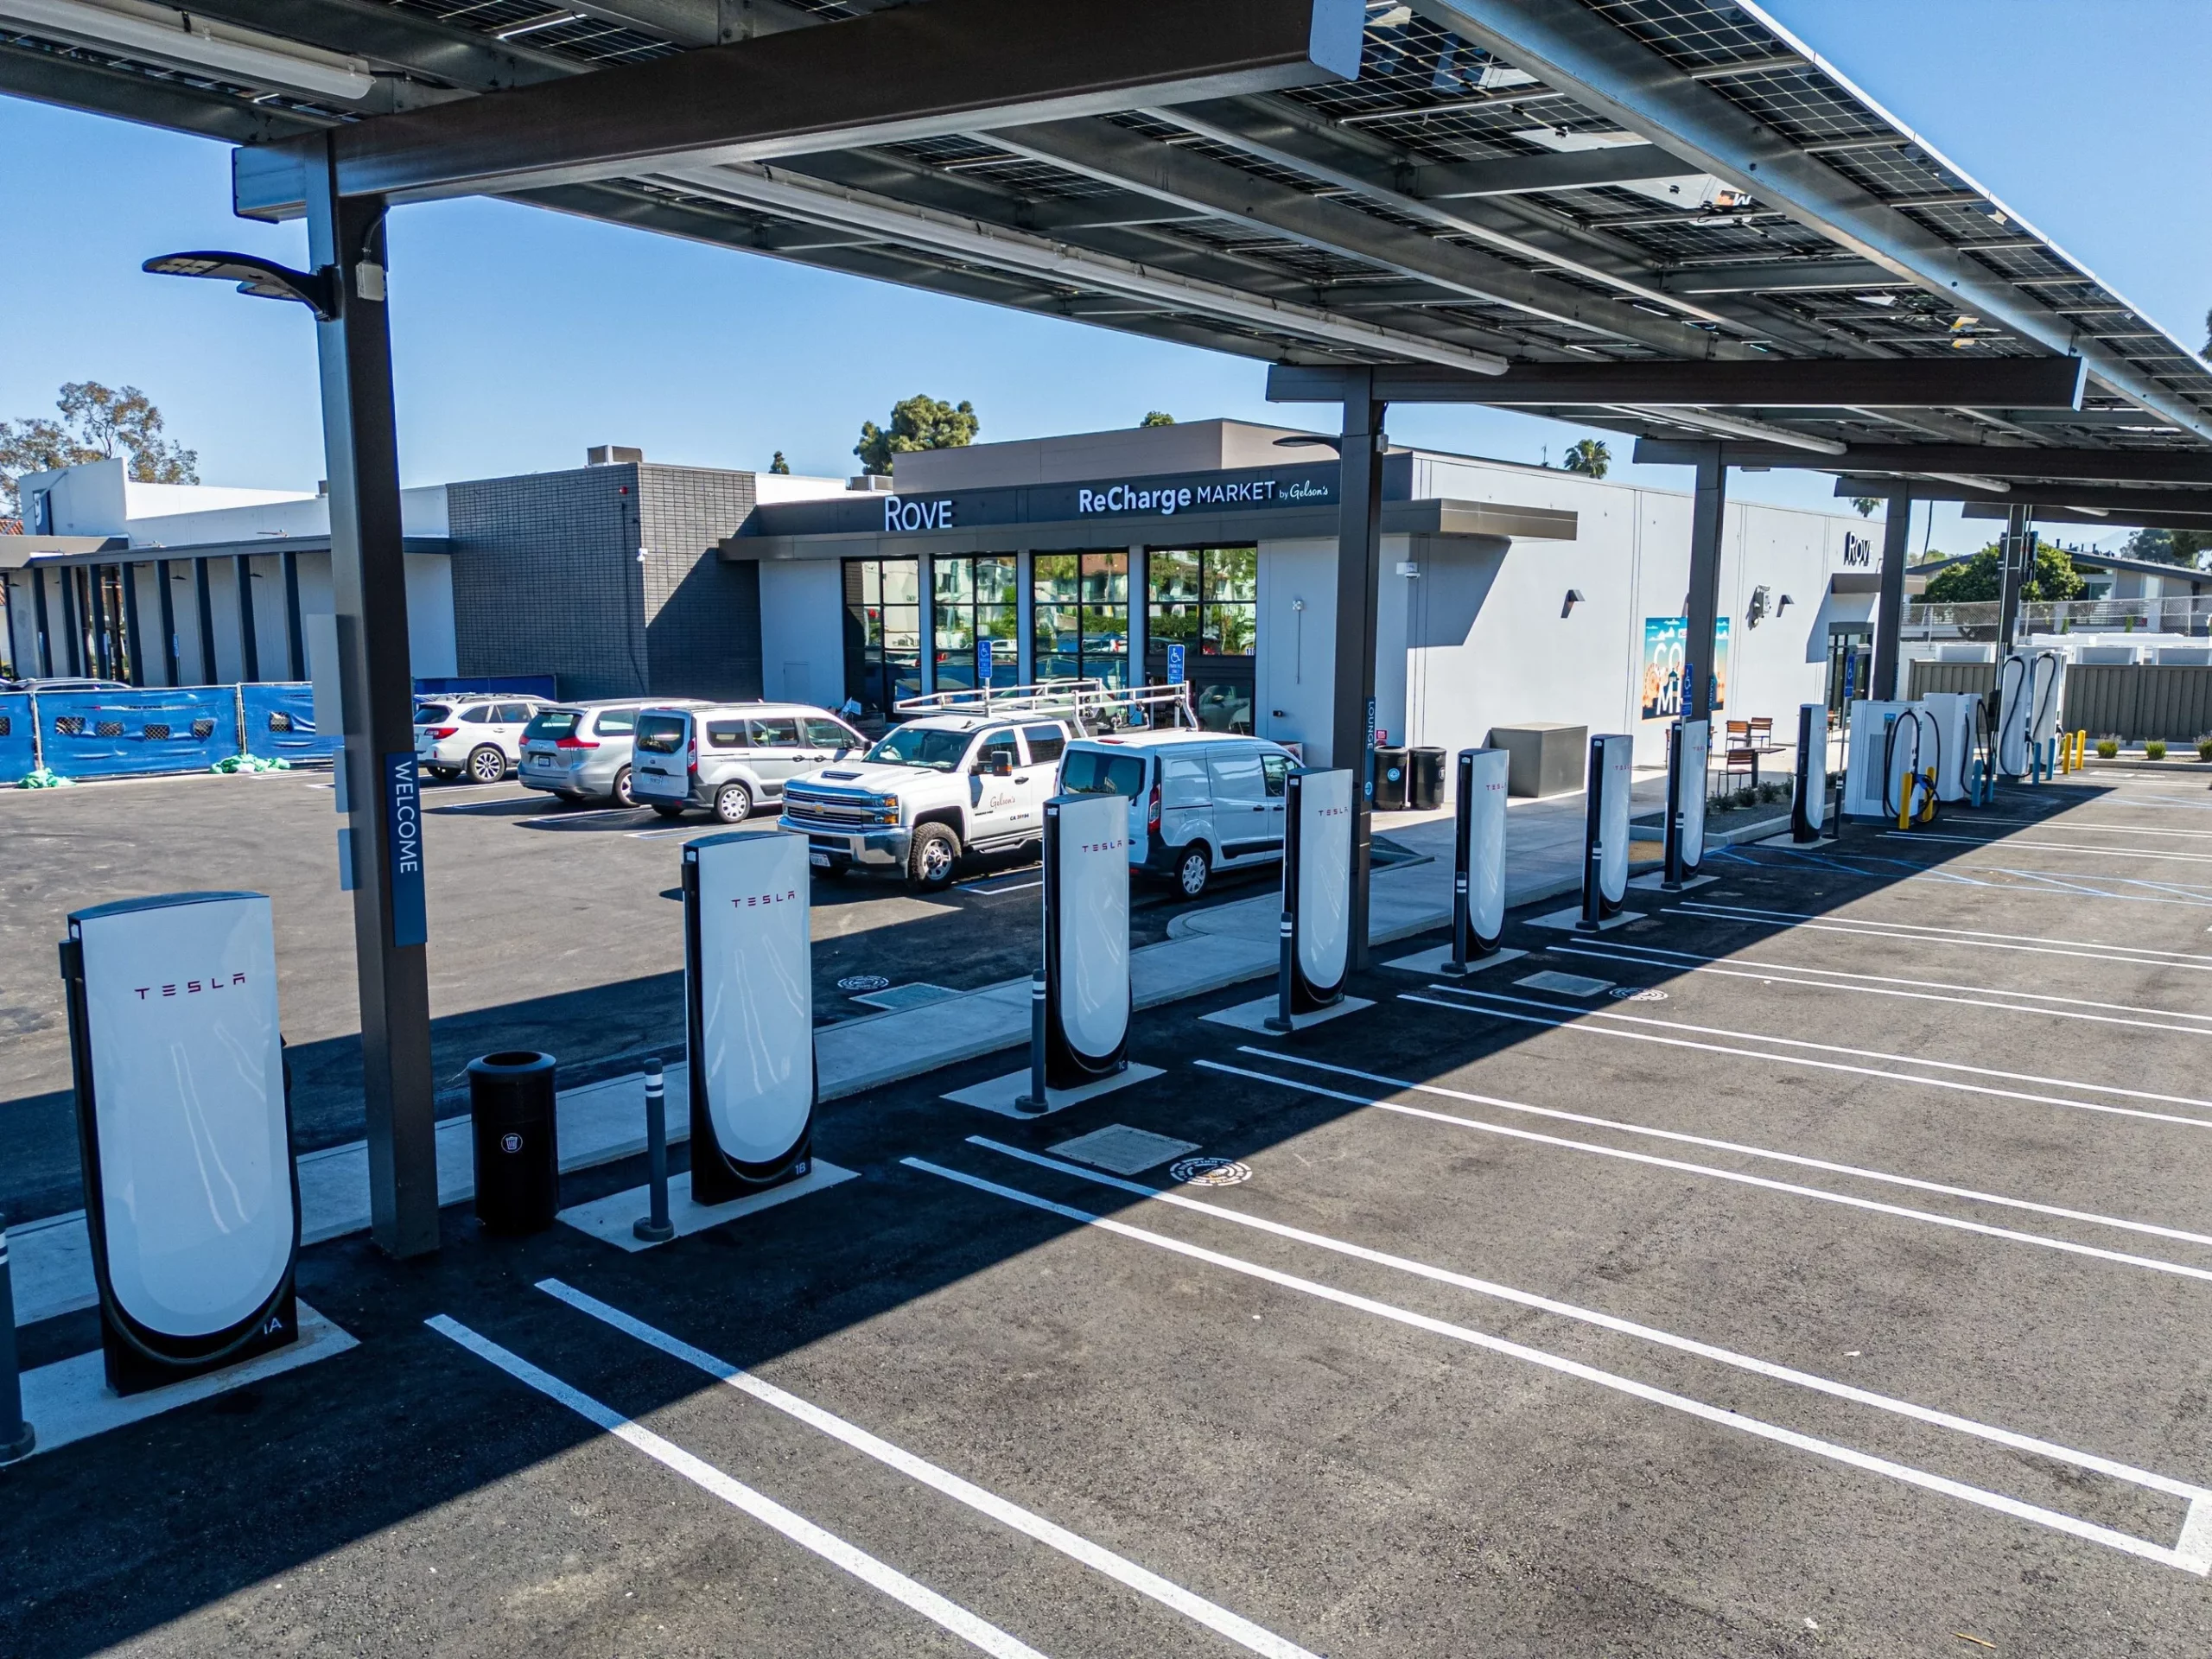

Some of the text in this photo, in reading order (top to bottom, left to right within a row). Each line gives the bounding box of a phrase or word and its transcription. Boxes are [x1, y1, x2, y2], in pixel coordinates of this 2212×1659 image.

[1079, 480, 1329, 515] ReCharge MARKET by Gelson's
[884, 495, 952, 531] ROVE
[989, 792, 1016, 810] Gelson's
[1318, 806, 1348, 817] TESLA
[395, 761, 418, 874] WELCOME
[1082, 840, 1122, 853] TESLA
[731, 890, 795, 908] TESLA
[134, 972, 245, 1000] TESLA
